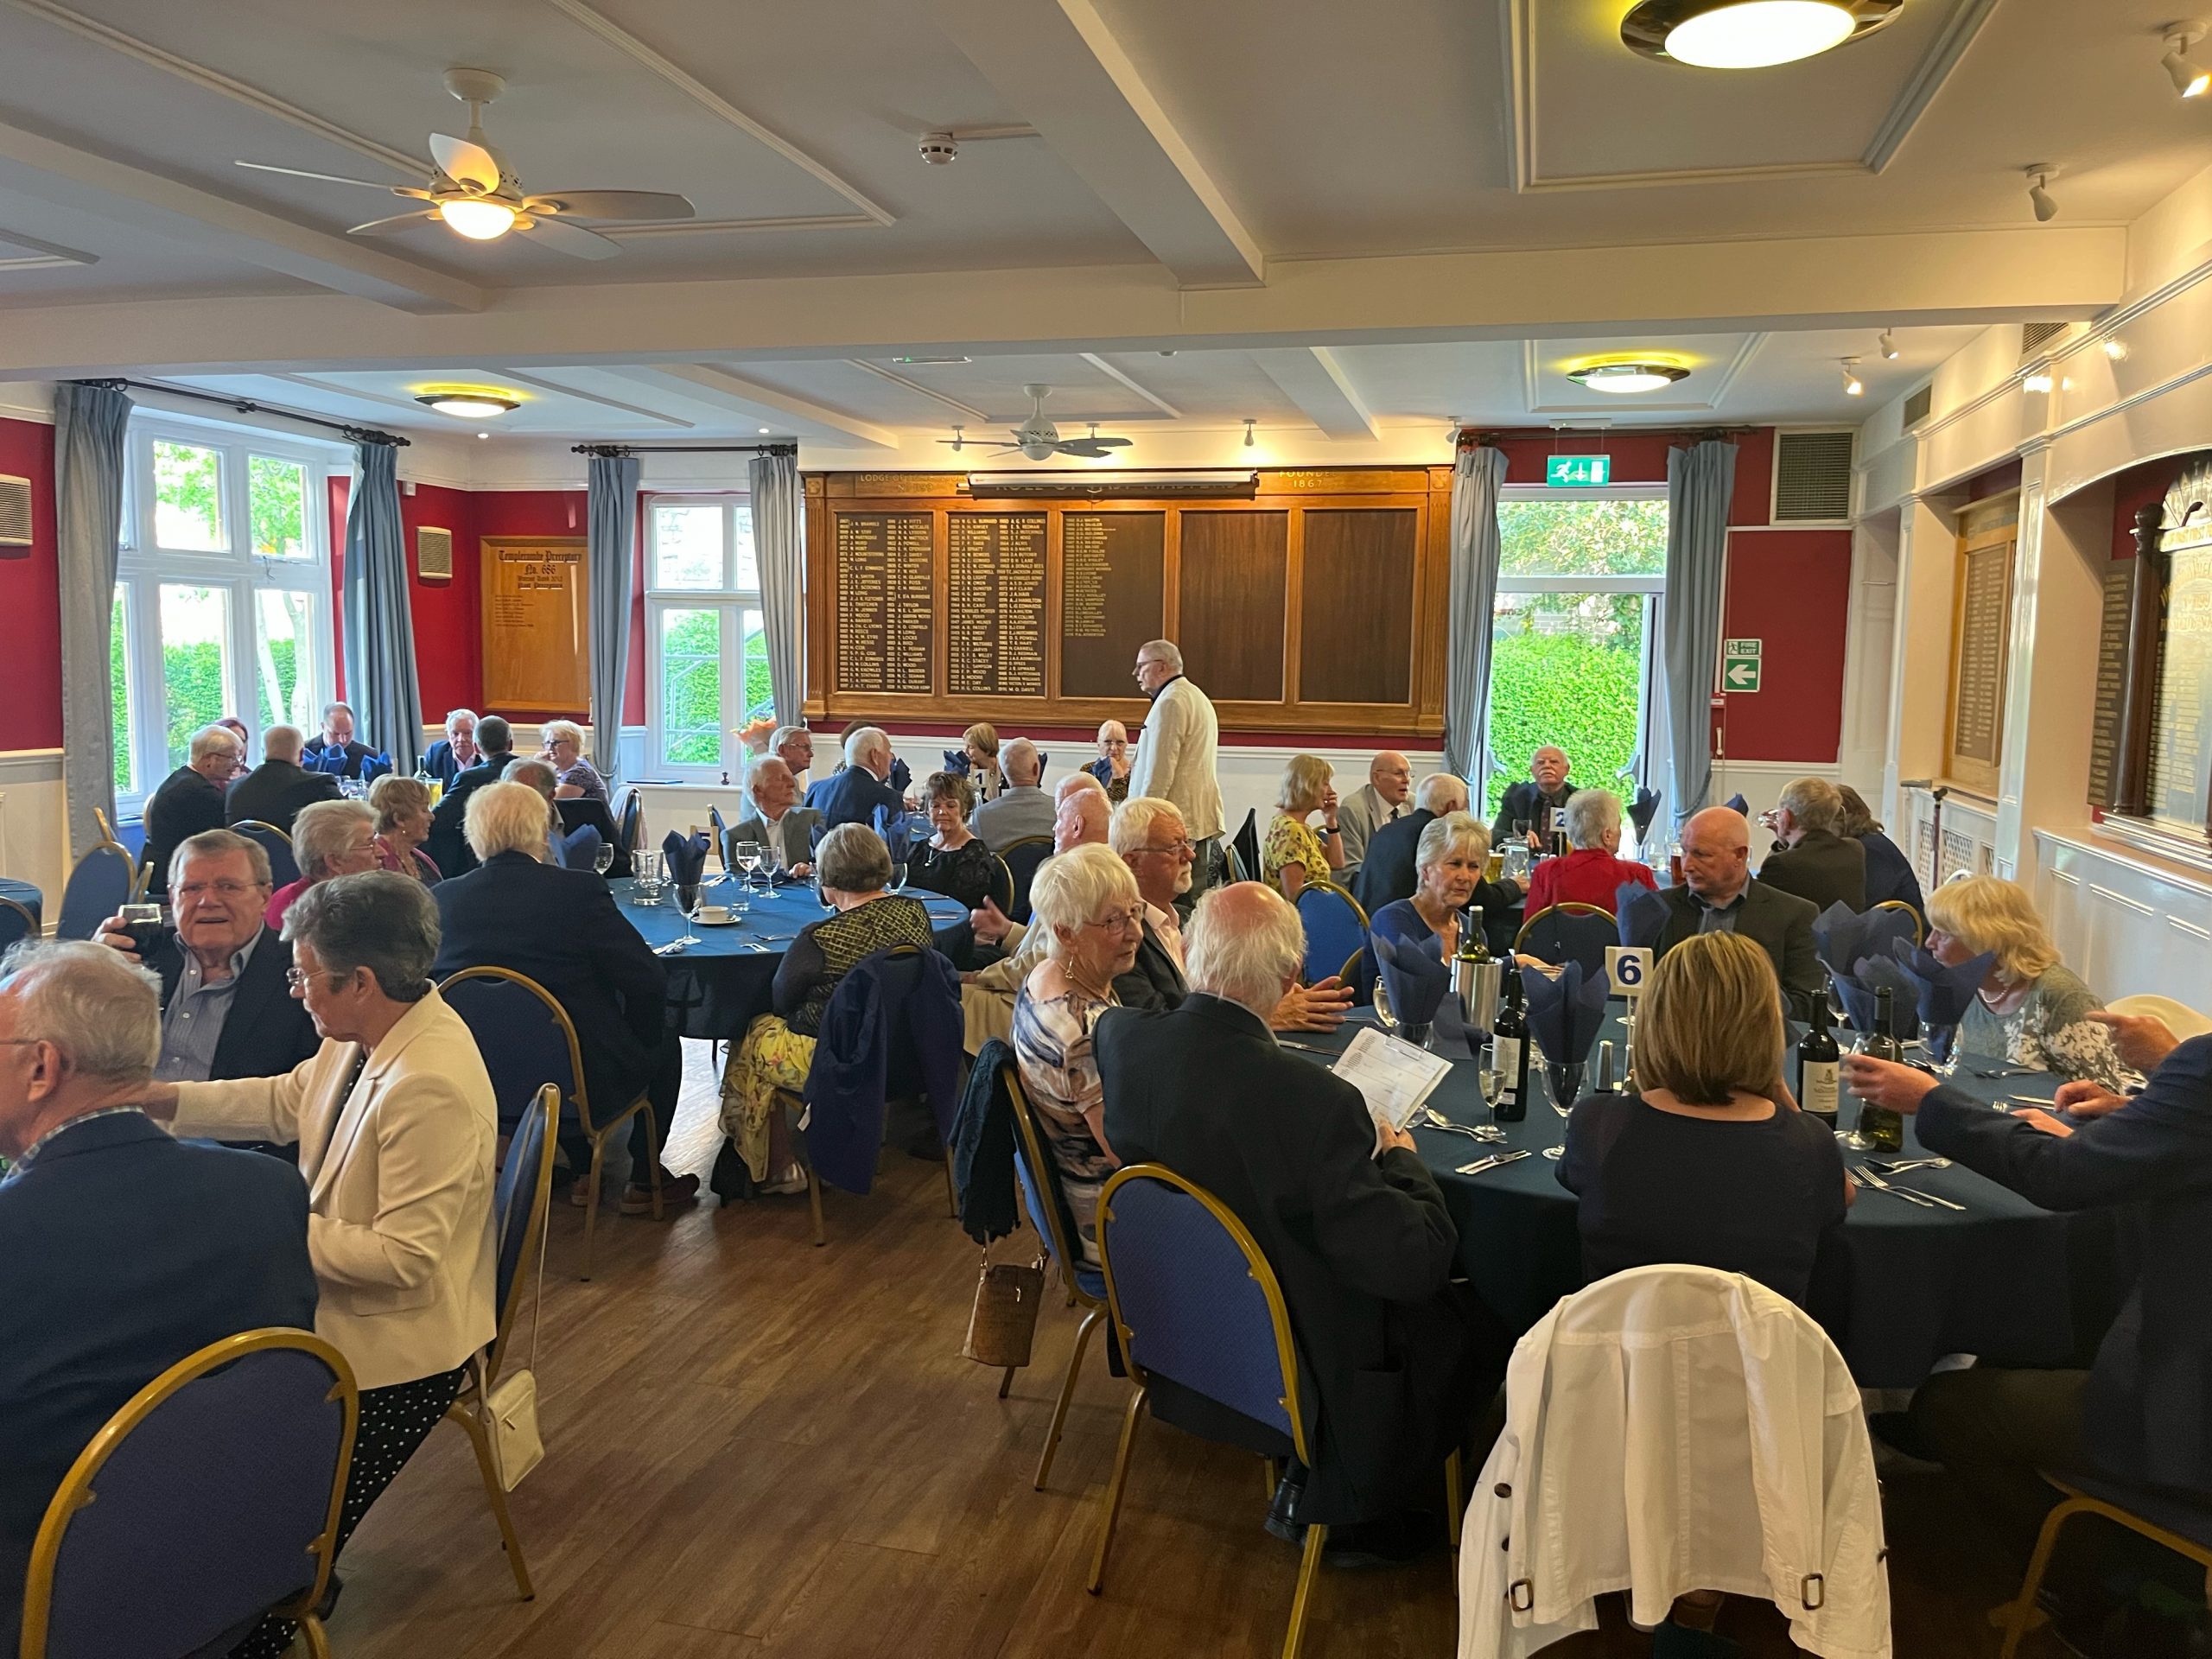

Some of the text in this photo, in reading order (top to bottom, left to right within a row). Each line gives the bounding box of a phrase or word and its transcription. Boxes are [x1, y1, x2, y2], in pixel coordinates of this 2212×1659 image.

[1293, 480, 1323, 488] 1867
[975, 772, 982, 785] 1
[1555, 811, 1566, 827] 2
[1617, 955, 1642, 985] 6
